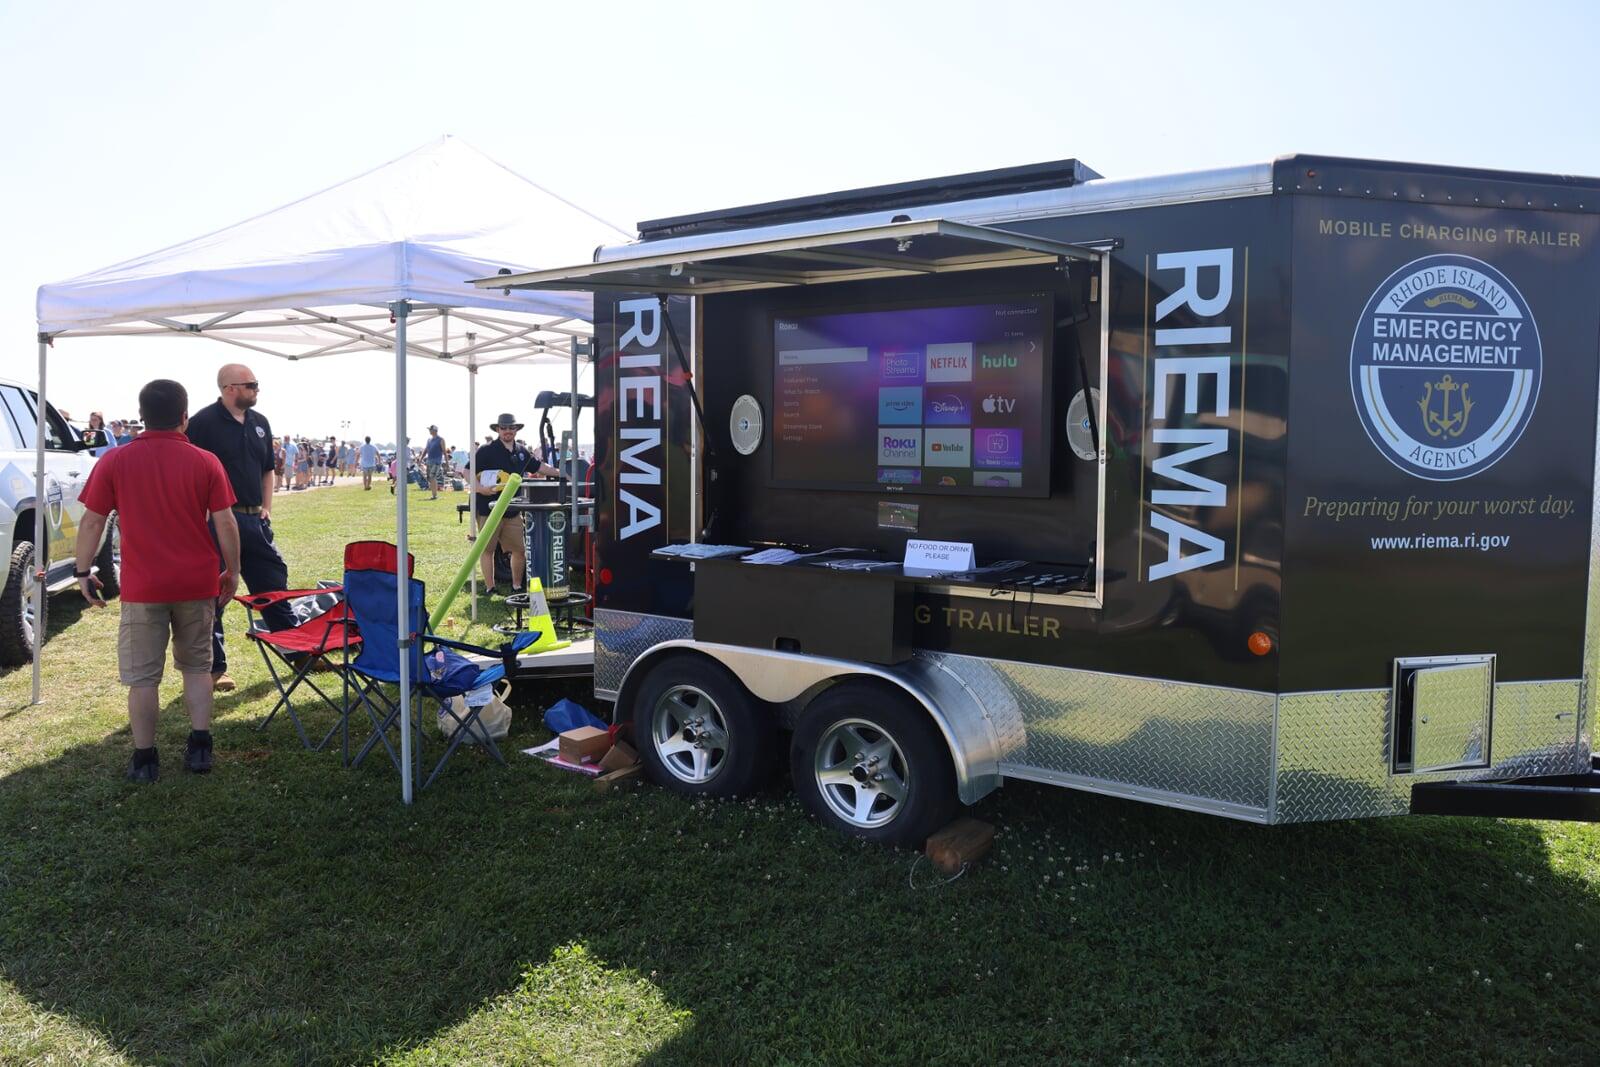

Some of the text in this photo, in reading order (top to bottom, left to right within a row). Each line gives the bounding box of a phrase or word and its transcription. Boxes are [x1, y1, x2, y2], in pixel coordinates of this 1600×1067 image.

[1319, 219, 1581, 248] MOBILE CHARGING TRAILER
[1389, 268, 1508, 312] RHODE ISLAND
[1373, 317, 1522, 342] EMERGENCY
[930, 356, 968, 370] NETFLIX
[982, 353, 1018, 369] hulu
[1372, 342, 1522, 365] MANAGEMENT
[997, 396, 1016, 413] tv
[1148, 247, 1234, 582] RIEMA
[619, 297, 662, 541] RIEMA
[883, 436, 916, 449] Roku
[883, 449, 916, 458] Channel
[942, 443, 964, 453] YouTube
[1409, 443, 1479, 469] AGENCY
[1303, 495, 1576, 522] Preparing for your worst day.
[919, 543, 938, 551] FOOD
[949, 545, 970, 553] DRINK
[1371, 532, 1510, 552] www.riema.ri.gov
[553, 535, 564, 584] RIEMA
[925, 552, 950, 560] PLEASE
[942, 607, 1061, 639] TRAILER
